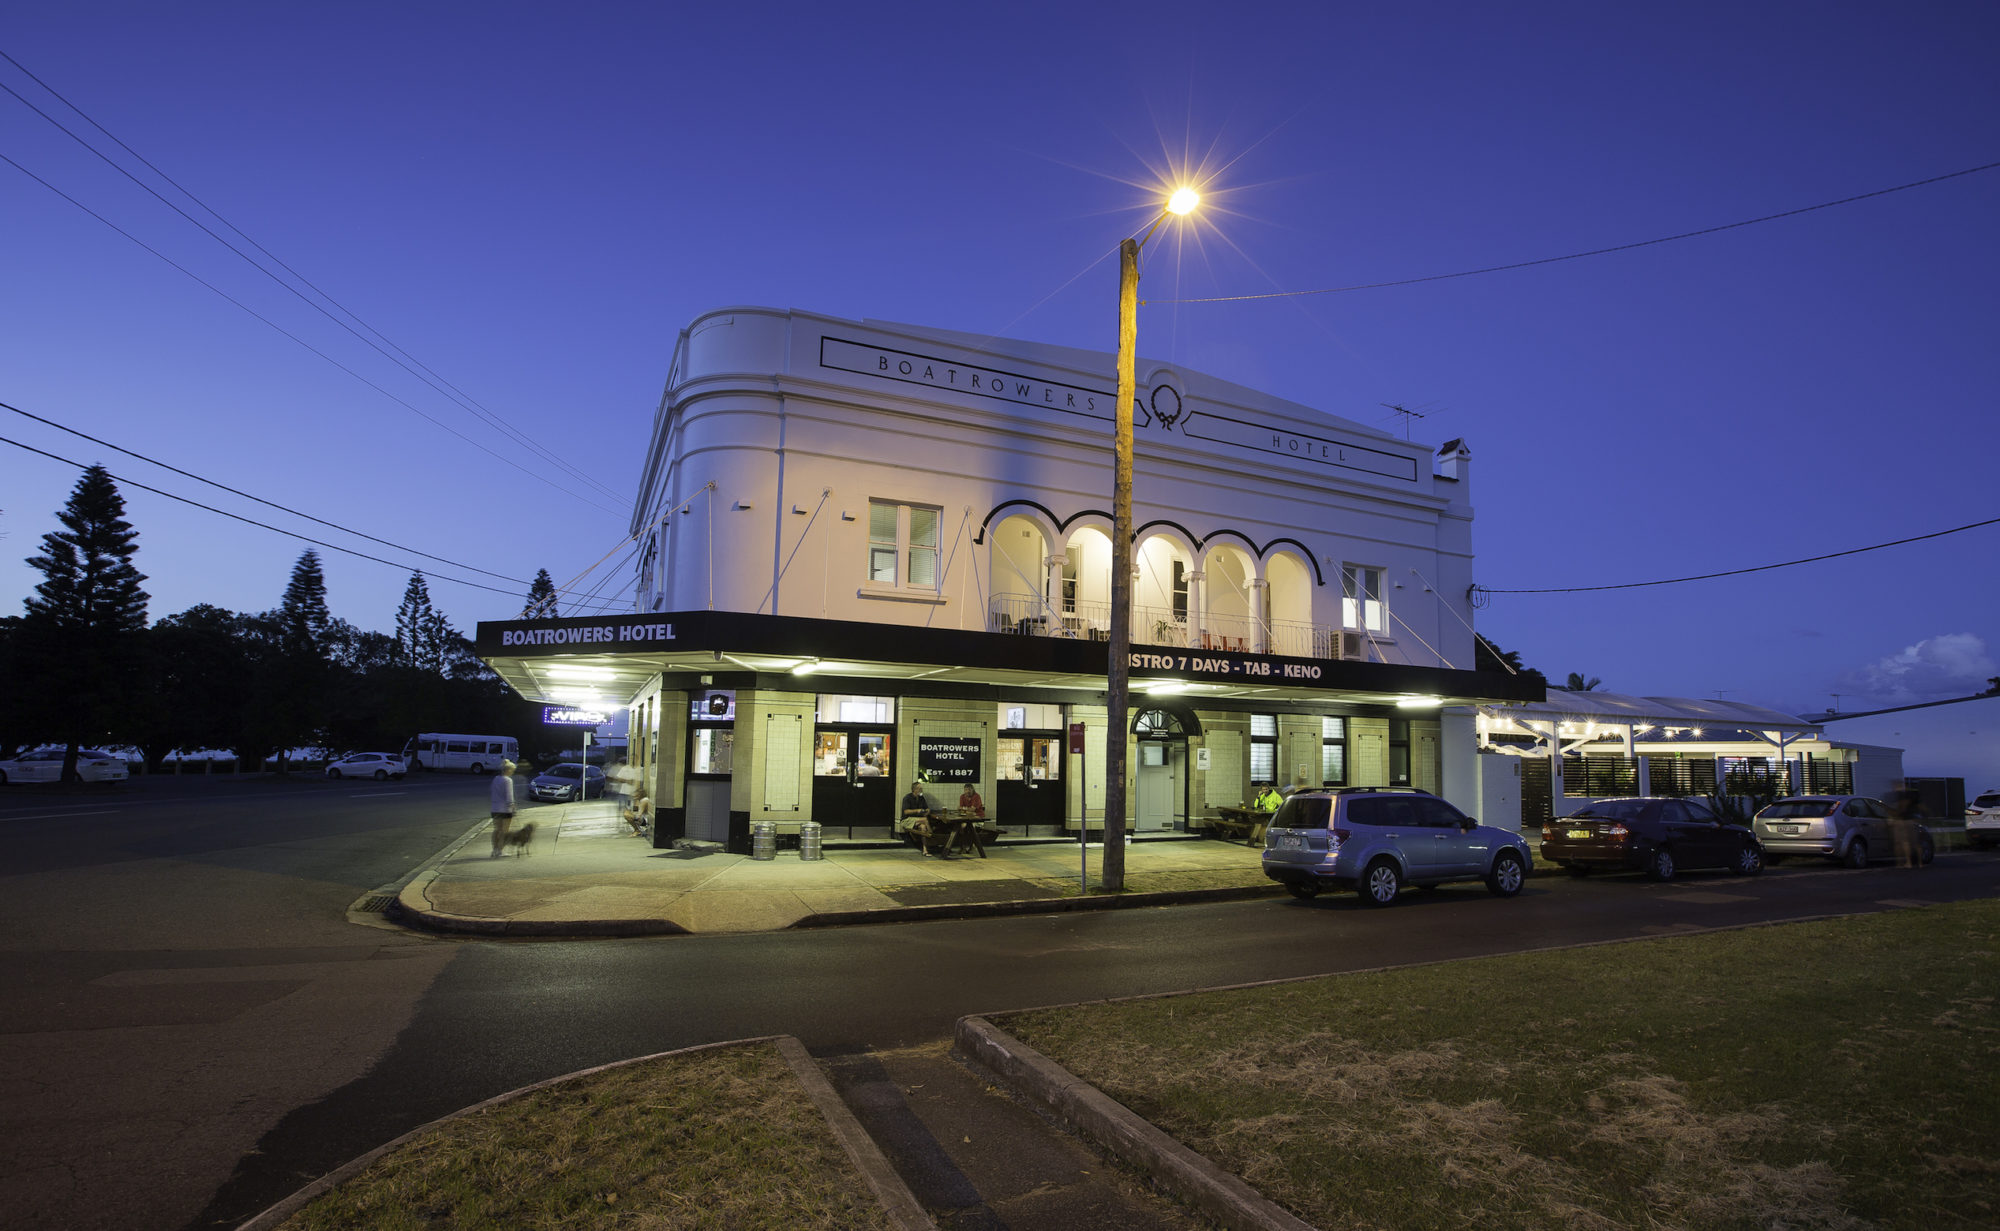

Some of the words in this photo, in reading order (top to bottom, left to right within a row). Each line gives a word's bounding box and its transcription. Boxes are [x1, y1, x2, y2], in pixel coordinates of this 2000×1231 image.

[879, 356, 1095, 411] BOATROWERS
[1272, 434, 1346, 461] HOTEL
[502, 627, 614, 646] BOATROWERS
[619, 623, 676, 642] HOTEL
[1128, 653, 1174, 670] ISTRO
[1178, 657, 1187, 670] 7
[1192, 658, 1230, 673] DAYS
[1244, 661, 1271, 676] TAB
[1284, 664, 1322, 679] KENO
[920, 744, 979, 752] BOATROWERS
[935, 752, 964, 760] HOTEL
